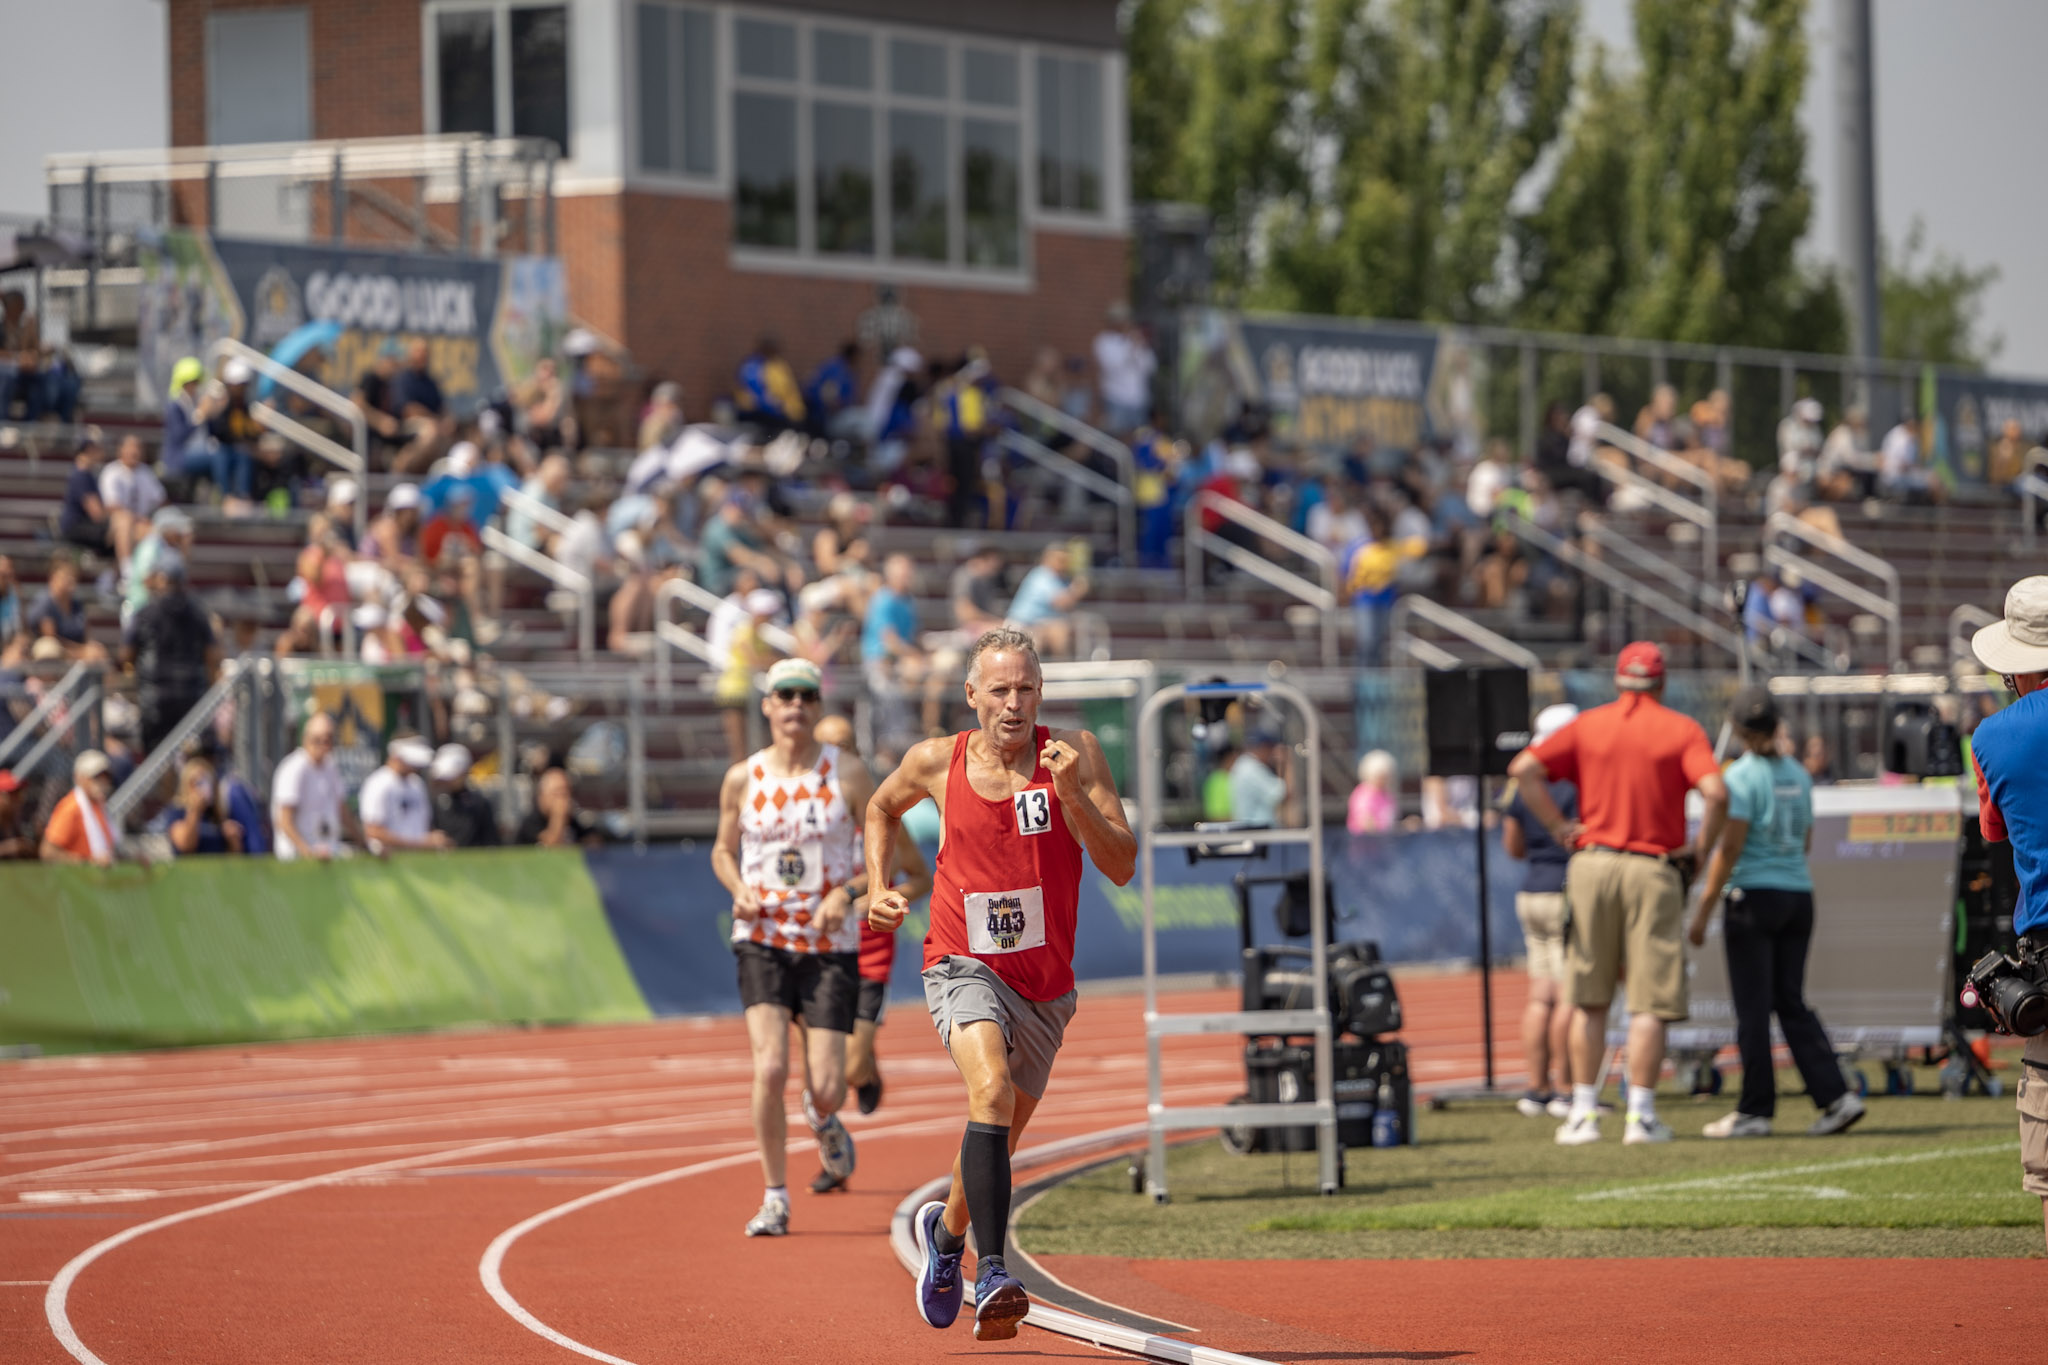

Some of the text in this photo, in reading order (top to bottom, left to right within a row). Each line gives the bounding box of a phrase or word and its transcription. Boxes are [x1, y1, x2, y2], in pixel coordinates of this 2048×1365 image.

[305, 271, 478, 334] GOOD LUCK
[1017, 791, 1049, 828] 13
[988, 897, 1021, 909] Durham
[988, 911, 1025, 934] 443
[1001, 937, 1015, 949] OH
